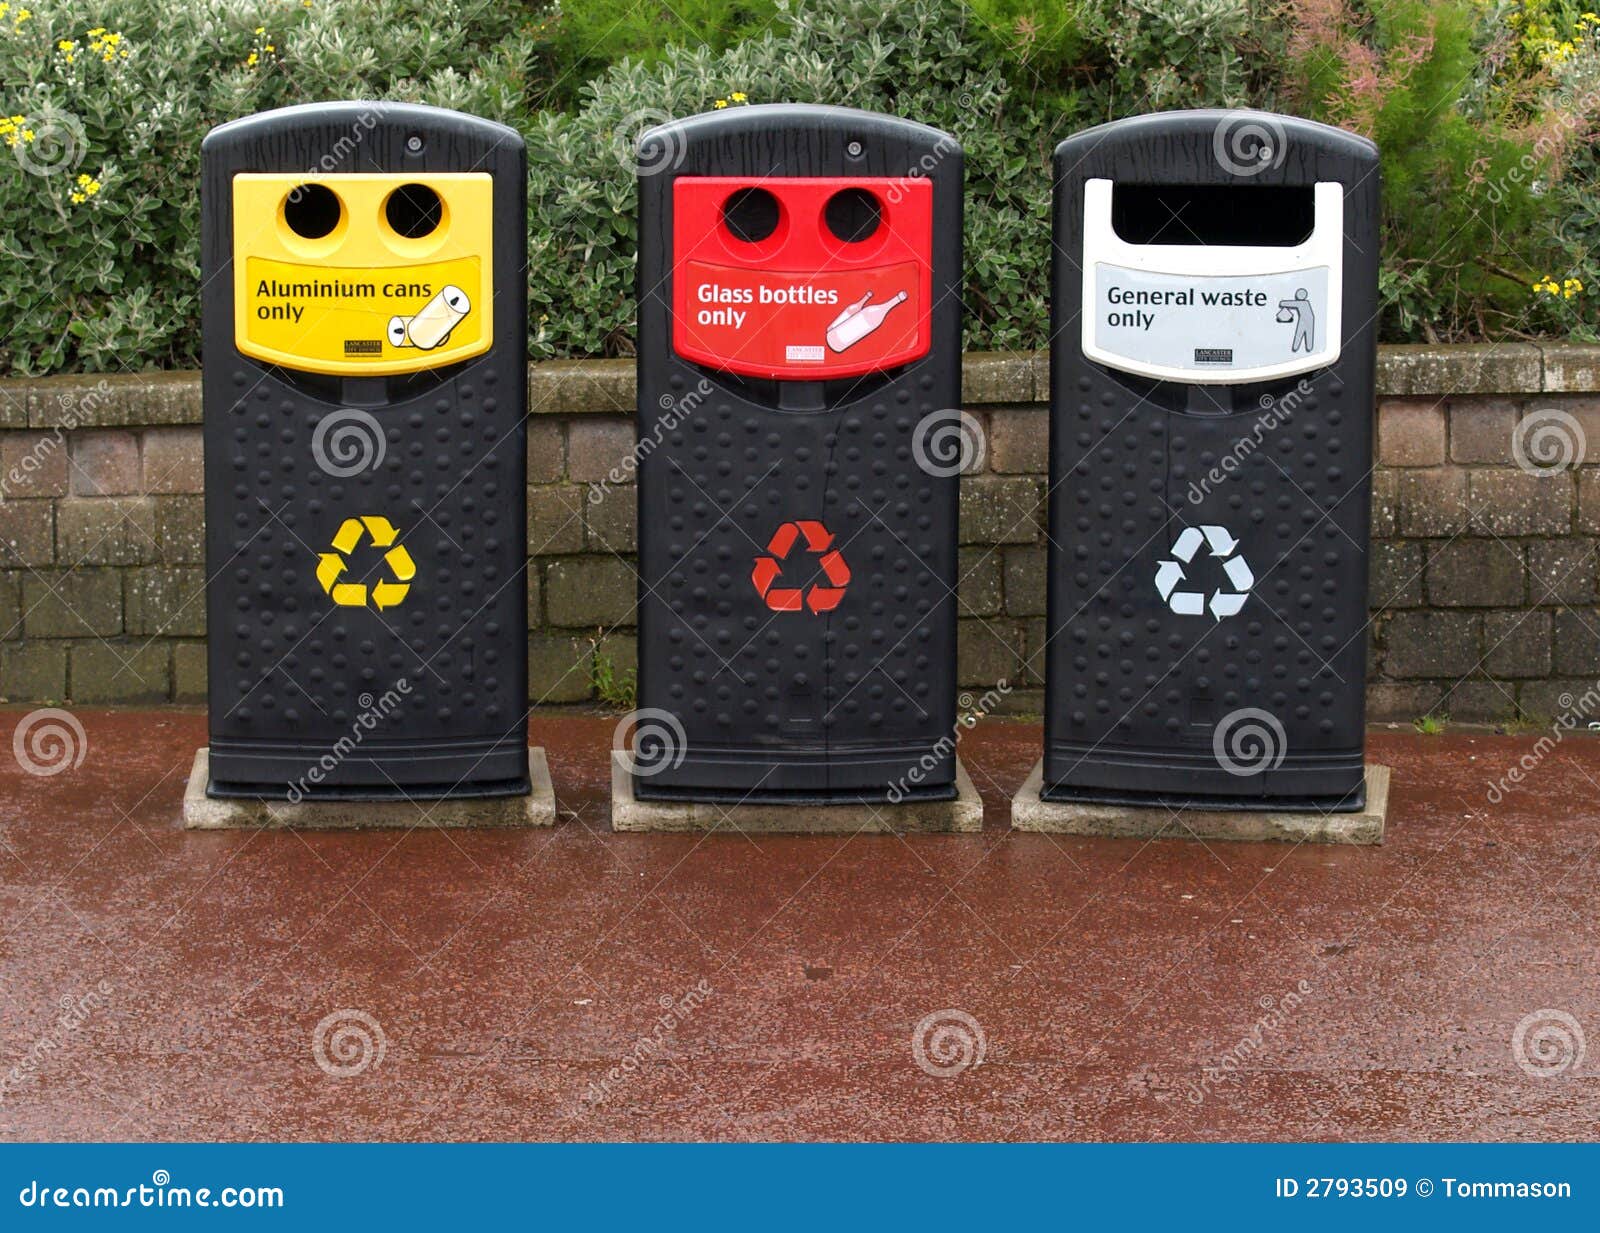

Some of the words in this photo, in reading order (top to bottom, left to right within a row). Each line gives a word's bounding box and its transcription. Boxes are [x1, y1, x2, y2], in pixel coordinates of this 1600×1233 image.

[256, 280, 376, 298] Aluminium
[382, 281, 432, 298] cans
[697, 284, 753, 304] Glass
[759, 285, 838, 305] bottles
[1107, 287, 1194, 305] General
[1201, 288, 1268, 306] waste
[257, 301, 304, 324] only
[697, 307, 746, 329] only
[1107, 310, 1155, 331] only
